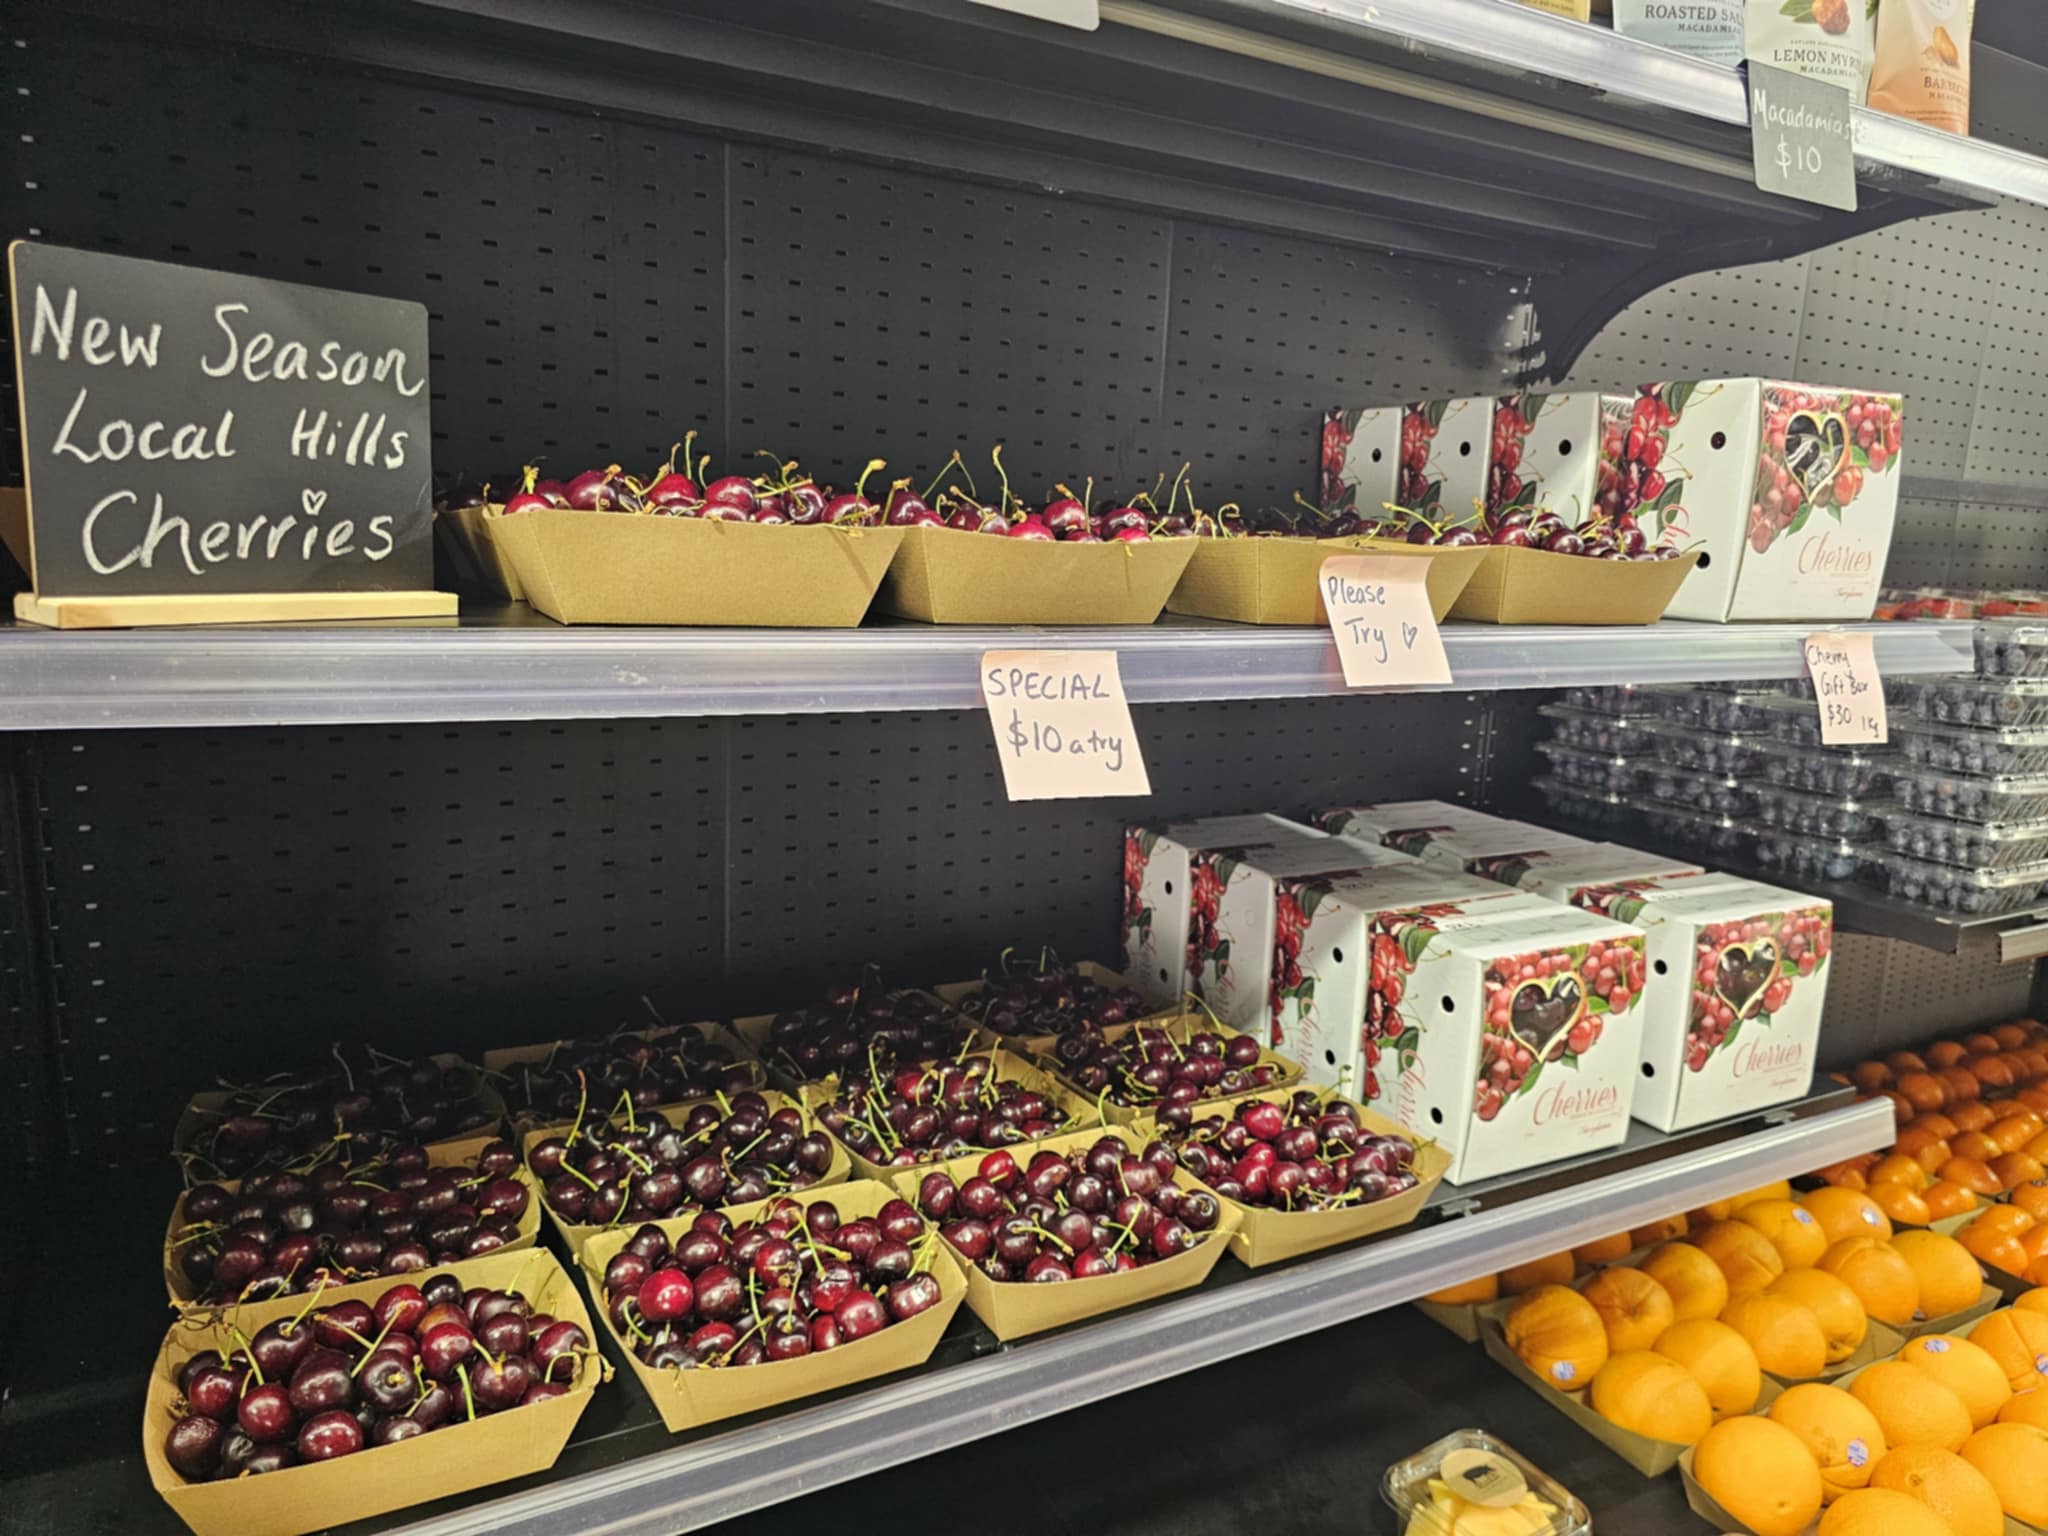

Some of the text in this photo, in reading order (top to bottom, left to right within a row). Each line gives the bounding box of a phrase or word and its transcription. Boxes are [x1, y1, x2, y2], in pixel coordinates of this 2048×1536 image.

[1645, 4, 1717, 20] ROASTED
[1774, 49, 1828, 64] LEMON
[1775, 133, 1822, 180] $10
[30, 284, 425, 396] New Season
[52, 388, 408, 470] Local Hills
[82, 489, 394, 575] Cherries
[1798, 531, 1872, 575] Cherries
[1327, 576, 1386, 605] Please
[1344, 617, 1388, 664] Try
[1806, 645, 1850, 668] Cherry
[987, 668, 1110, 700] SPECIAL
[1821, 672, 1844, 696] Gift
[1006, 708, 1062, 757] $10
[1827, 701, 1852, 726] $30
[1733, 1034, 1802, 1078] Cherries
[1533, 1078, 1617, 1126] Cherries
